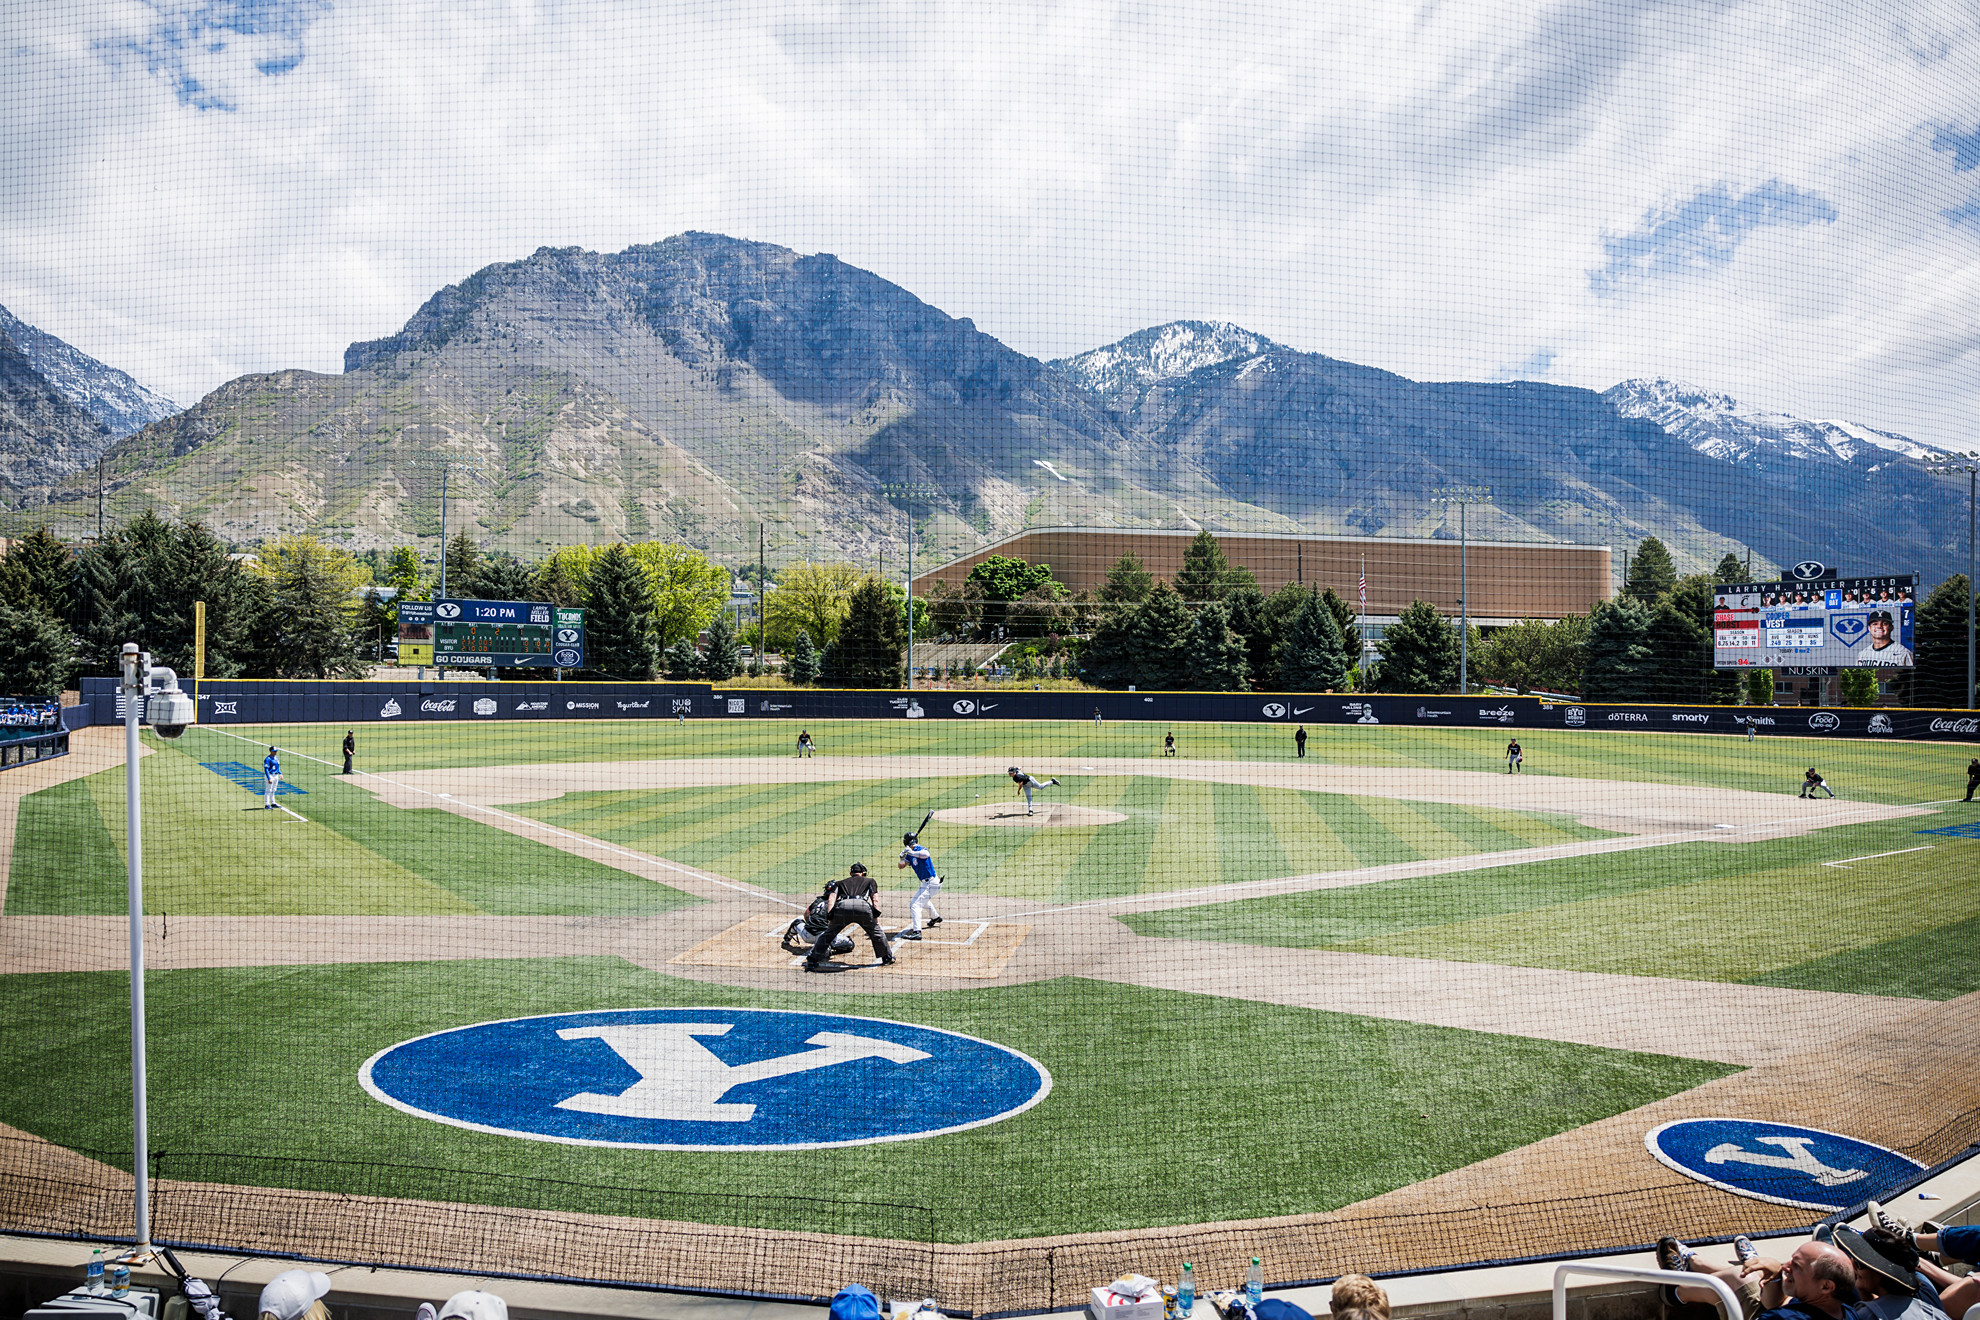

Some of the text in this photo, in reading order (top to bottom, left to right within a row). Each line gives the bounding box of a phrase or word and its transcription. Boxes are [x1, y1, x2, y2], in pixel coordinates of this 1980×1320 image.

[1728, 578, 1896, 594] LARRY H. MILLER FIELD
[401, 604, 424, 612] FOLLOW
[475, 607, 516, 618] 1:20 PM
[530, 614, 550, 623] FIELD
[1715, 613, 1734, 622] CHASE
[1765, 611, 1790, 620] COOPER
[1903, 610, 1910, 619] 7
[1715, 620, 1740, 629] HORST
[1765, 619, 1786, 628] VEST
[471, 627, 477, 635] 0
[494, 627, 501, 636] 2
[436, 655, 449, 664] GO
[450, 655, 493, 664] COUGARS
[1737, 658, 1749, 666] 94
[1788, 666, 1829, 675] NU SKIN
[420, 699, 457, 712] Coca-Cola
[1567, 707, 1583, 716] BYU
[1671, 712, 1710, 725] smarty
[1746, 715, 1776, 726] Smith's
[1814, 715, 1834, 724] Food
[1929, 717, 1980, 733] Coca-Cola
